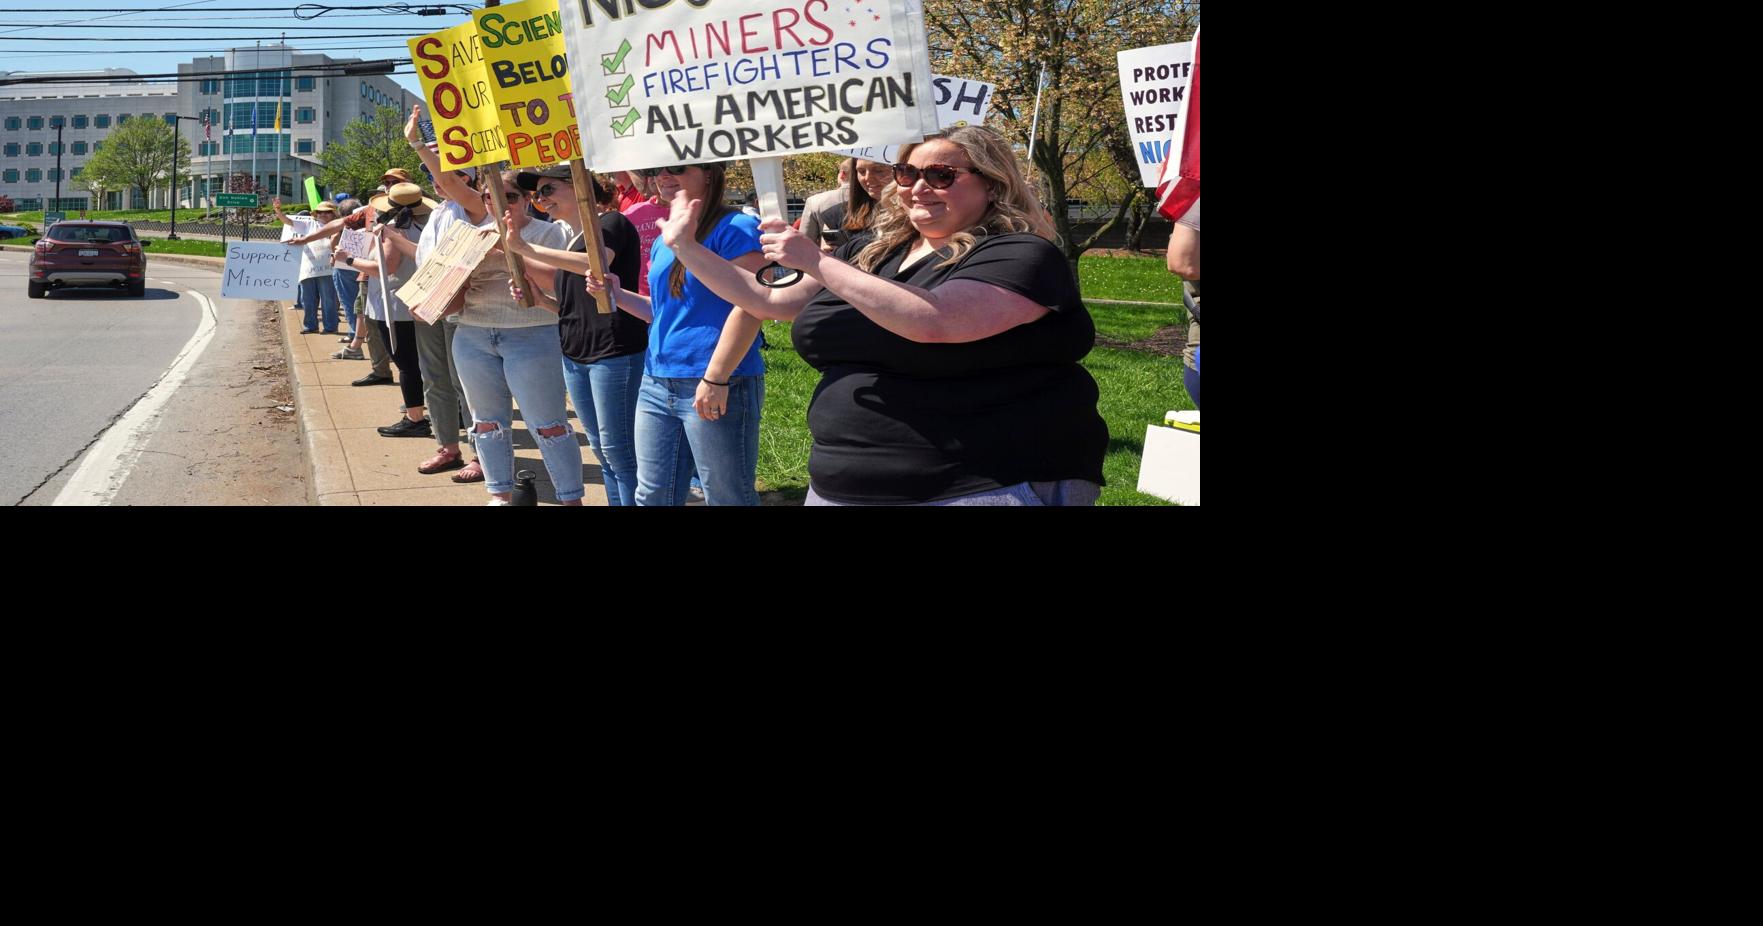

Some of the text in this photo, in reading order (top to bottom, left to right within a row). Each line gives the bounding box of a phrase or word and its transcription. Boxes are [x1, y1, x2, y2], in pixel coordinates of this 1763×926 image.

[644, 0, 834, 67] MINERS
[491, 53, 569, 89] BELO
[643, 38, 892, 98] FIREFIGHTERS
[500, 98, 549, 127] TO
[646, 72, 915, 134] ALL AMERICAN
[666, 116, 859, 161] WORKERS
[1134, 113, 1178, 134] REST
[230, 247, 292, 265] Support
[227, 268, 290, 289] Miners
